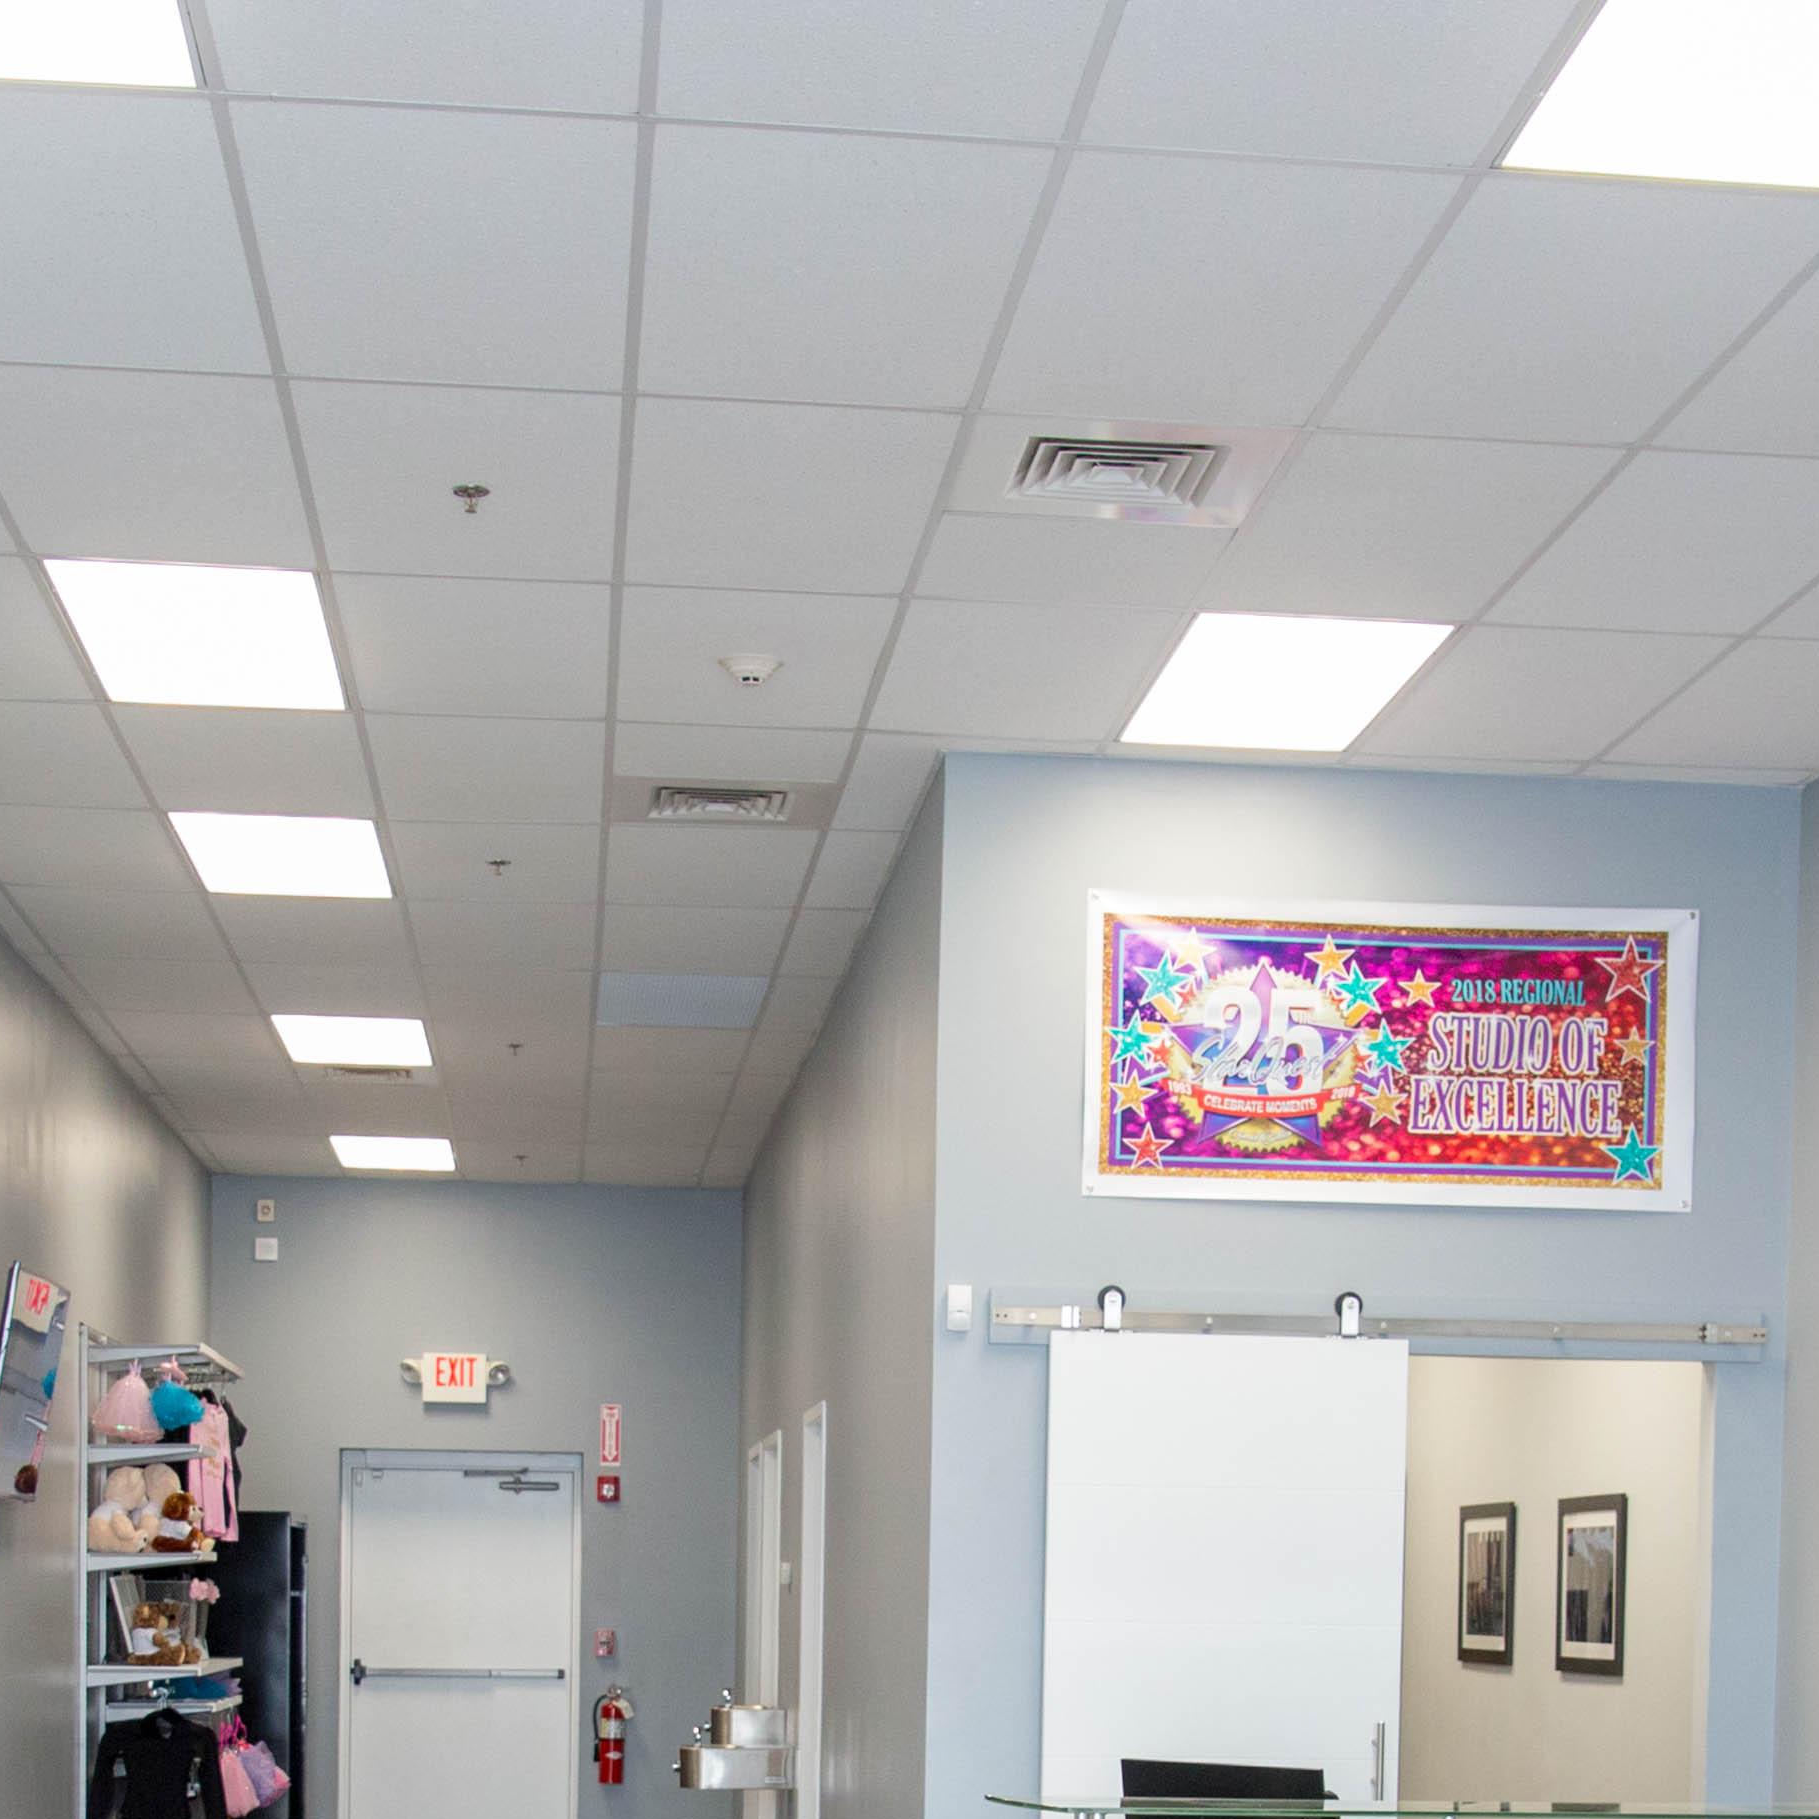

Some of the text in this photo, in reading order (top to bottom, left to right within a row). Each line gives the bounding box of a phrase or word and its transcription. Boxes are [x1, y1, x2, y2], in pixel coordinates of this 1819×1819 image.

[1452, 978, 1587, 1006] 2018 REGIONAL
[1429, 1012, 1607, 1075] STUDIO OF
[1203, 1094, 1318, 1114] CELEBRATE MOMENTS
[1410, 1076, 1622, 1137] EXCELLENCE
[436, 1356, 477, 1388] EXIT
